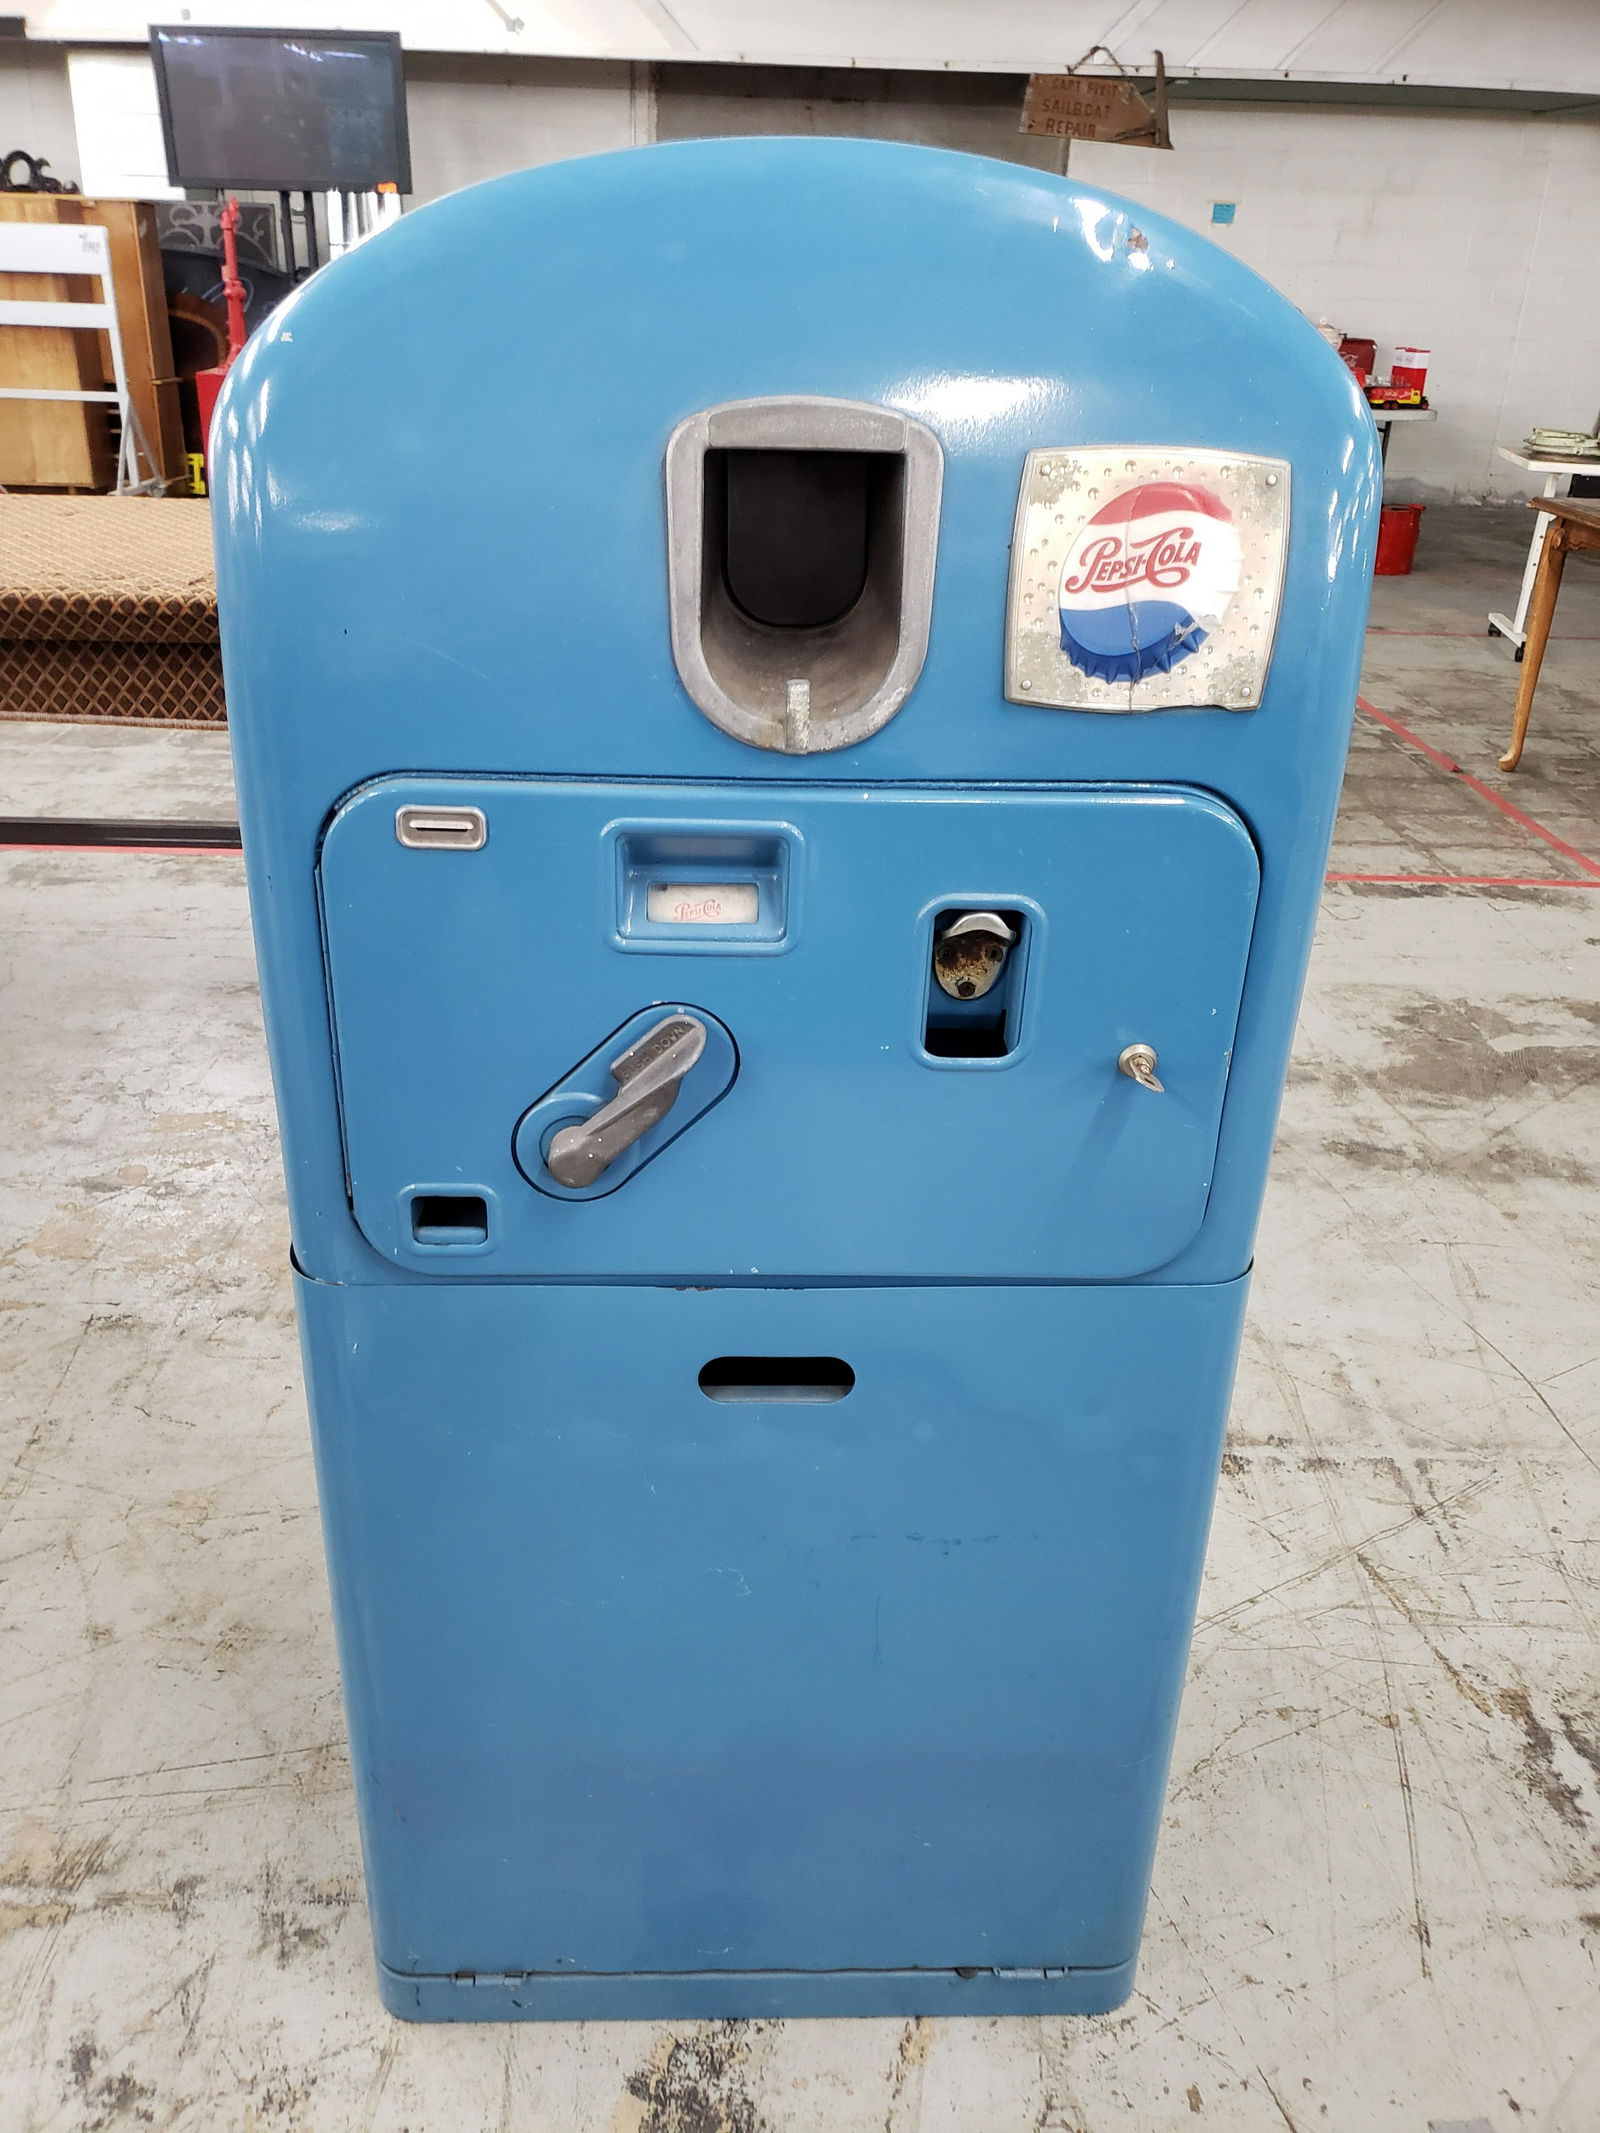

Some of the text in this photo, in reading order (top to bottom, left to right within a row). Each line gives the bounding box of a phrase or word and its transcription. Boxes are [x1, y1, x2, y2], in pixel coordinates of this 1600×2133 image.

[1042, 98, 1111, 119] SAILBOAT
[1046, 118, 1096, 137] REPAIR
[652, 1026, 685, 1055] DOWN
